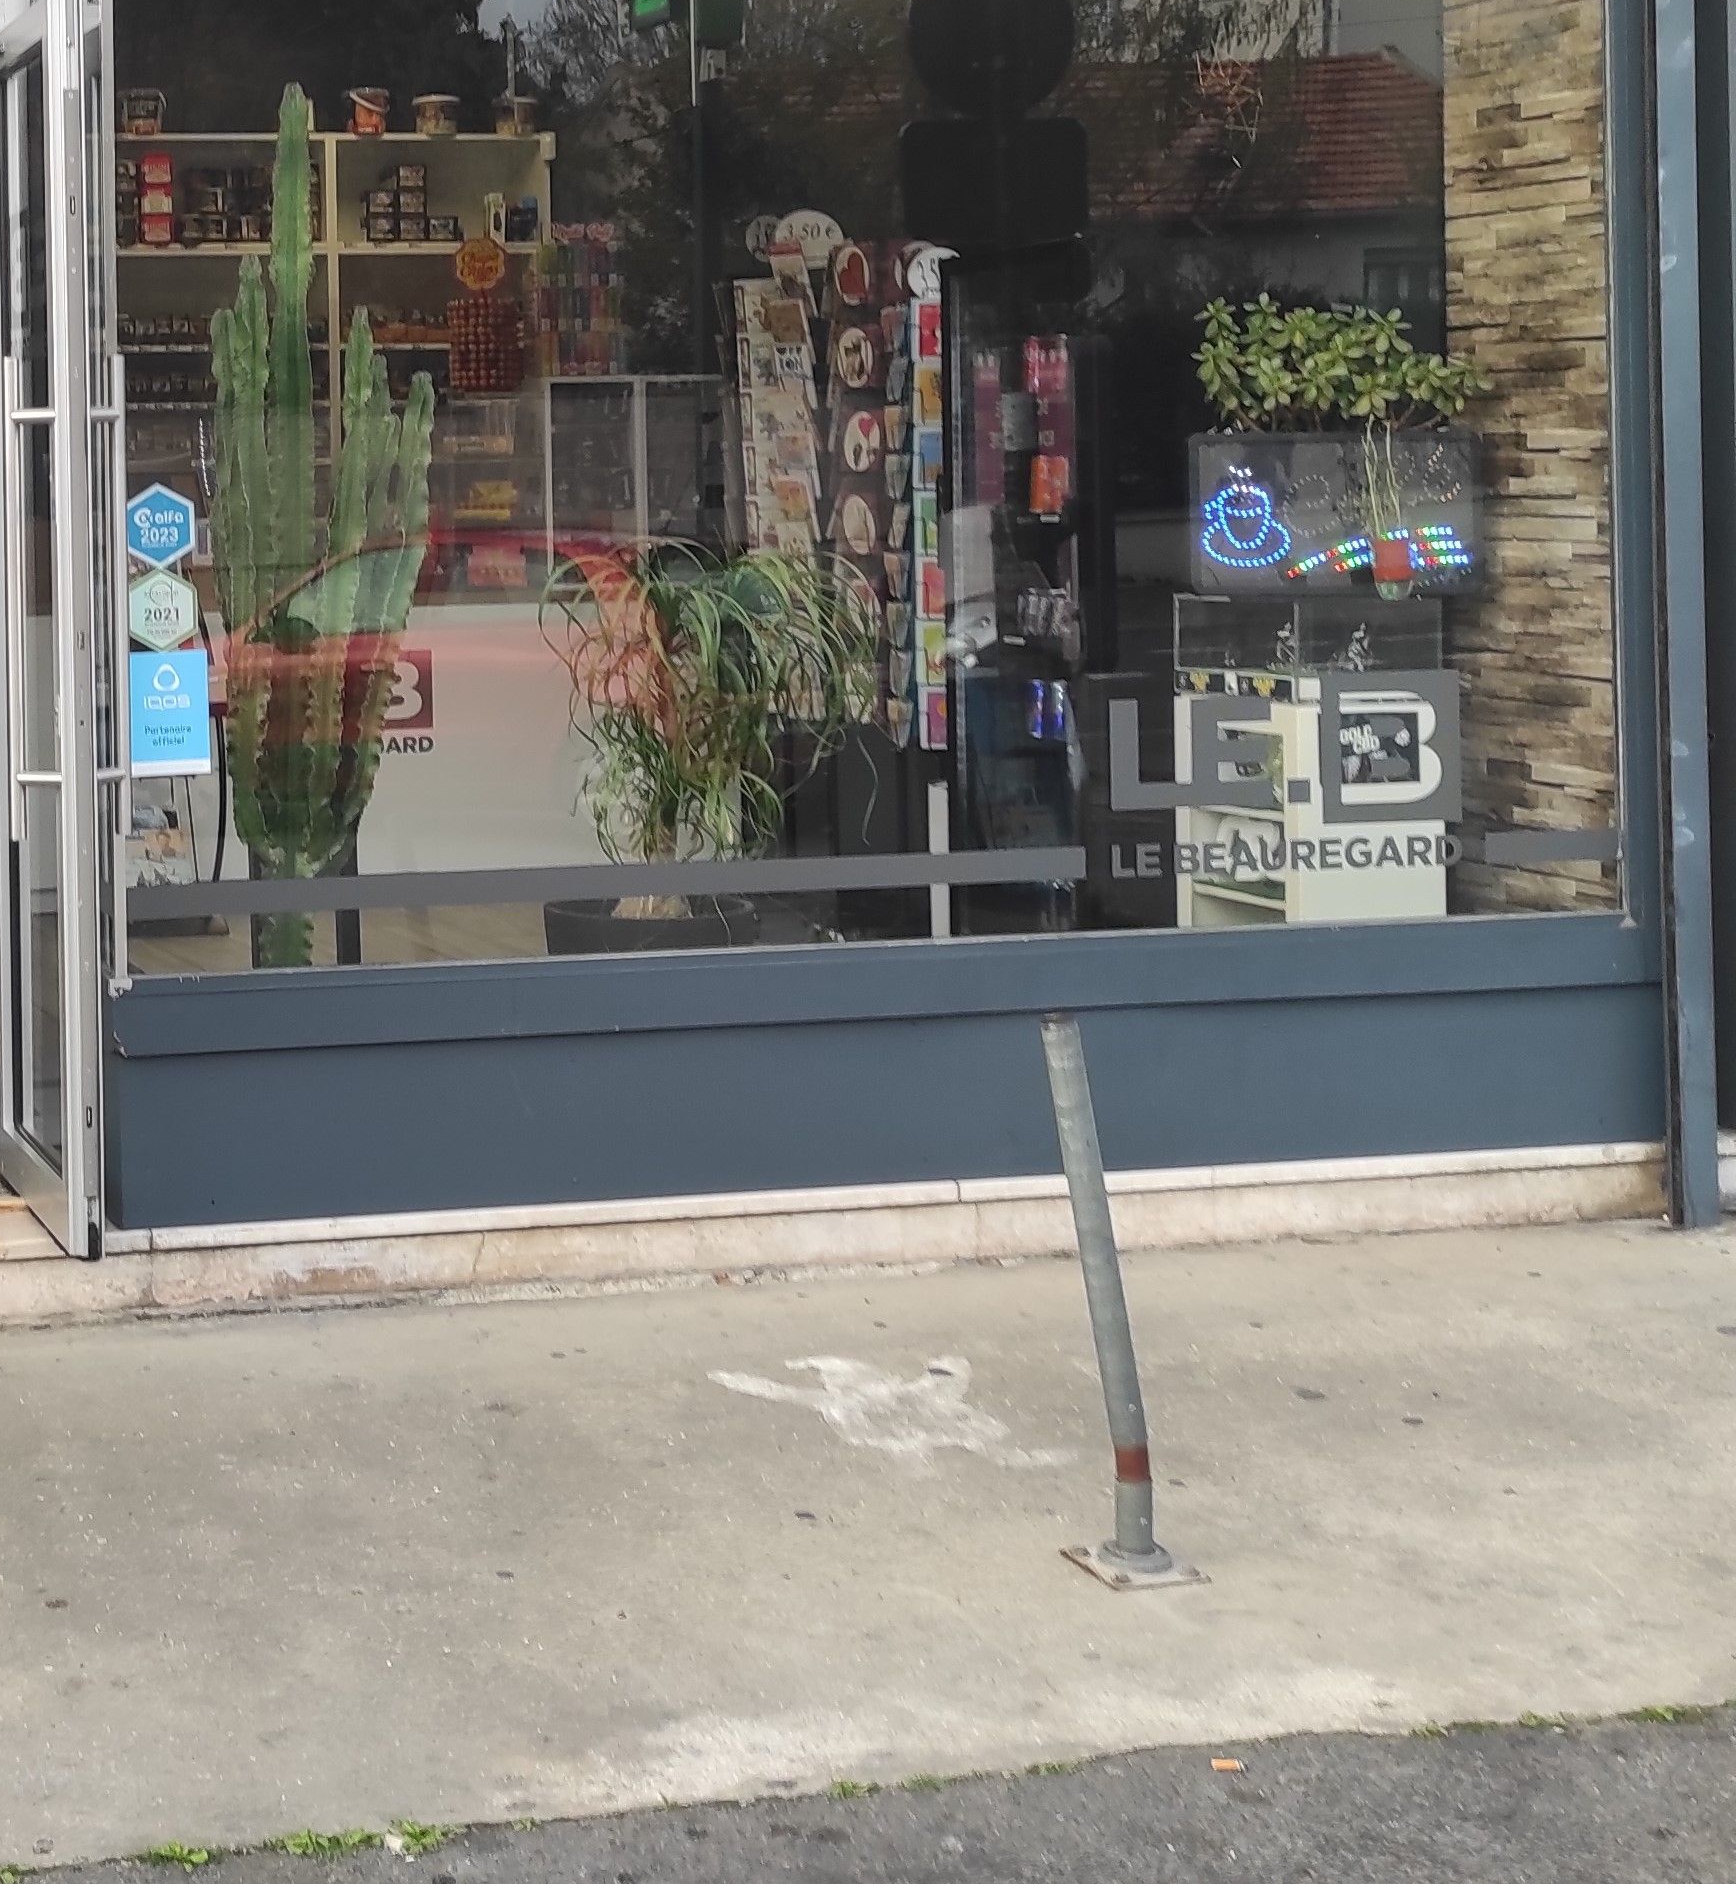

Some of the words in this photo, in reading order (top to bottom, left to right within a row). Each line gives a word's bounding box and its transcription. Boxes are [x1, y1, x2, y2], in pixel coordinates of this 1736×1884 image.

[144, 607, 179, 622] 2021
[1112, 843, 1162, 879] LE
[1174, 835, 1463, 875] BEAUREGARD
